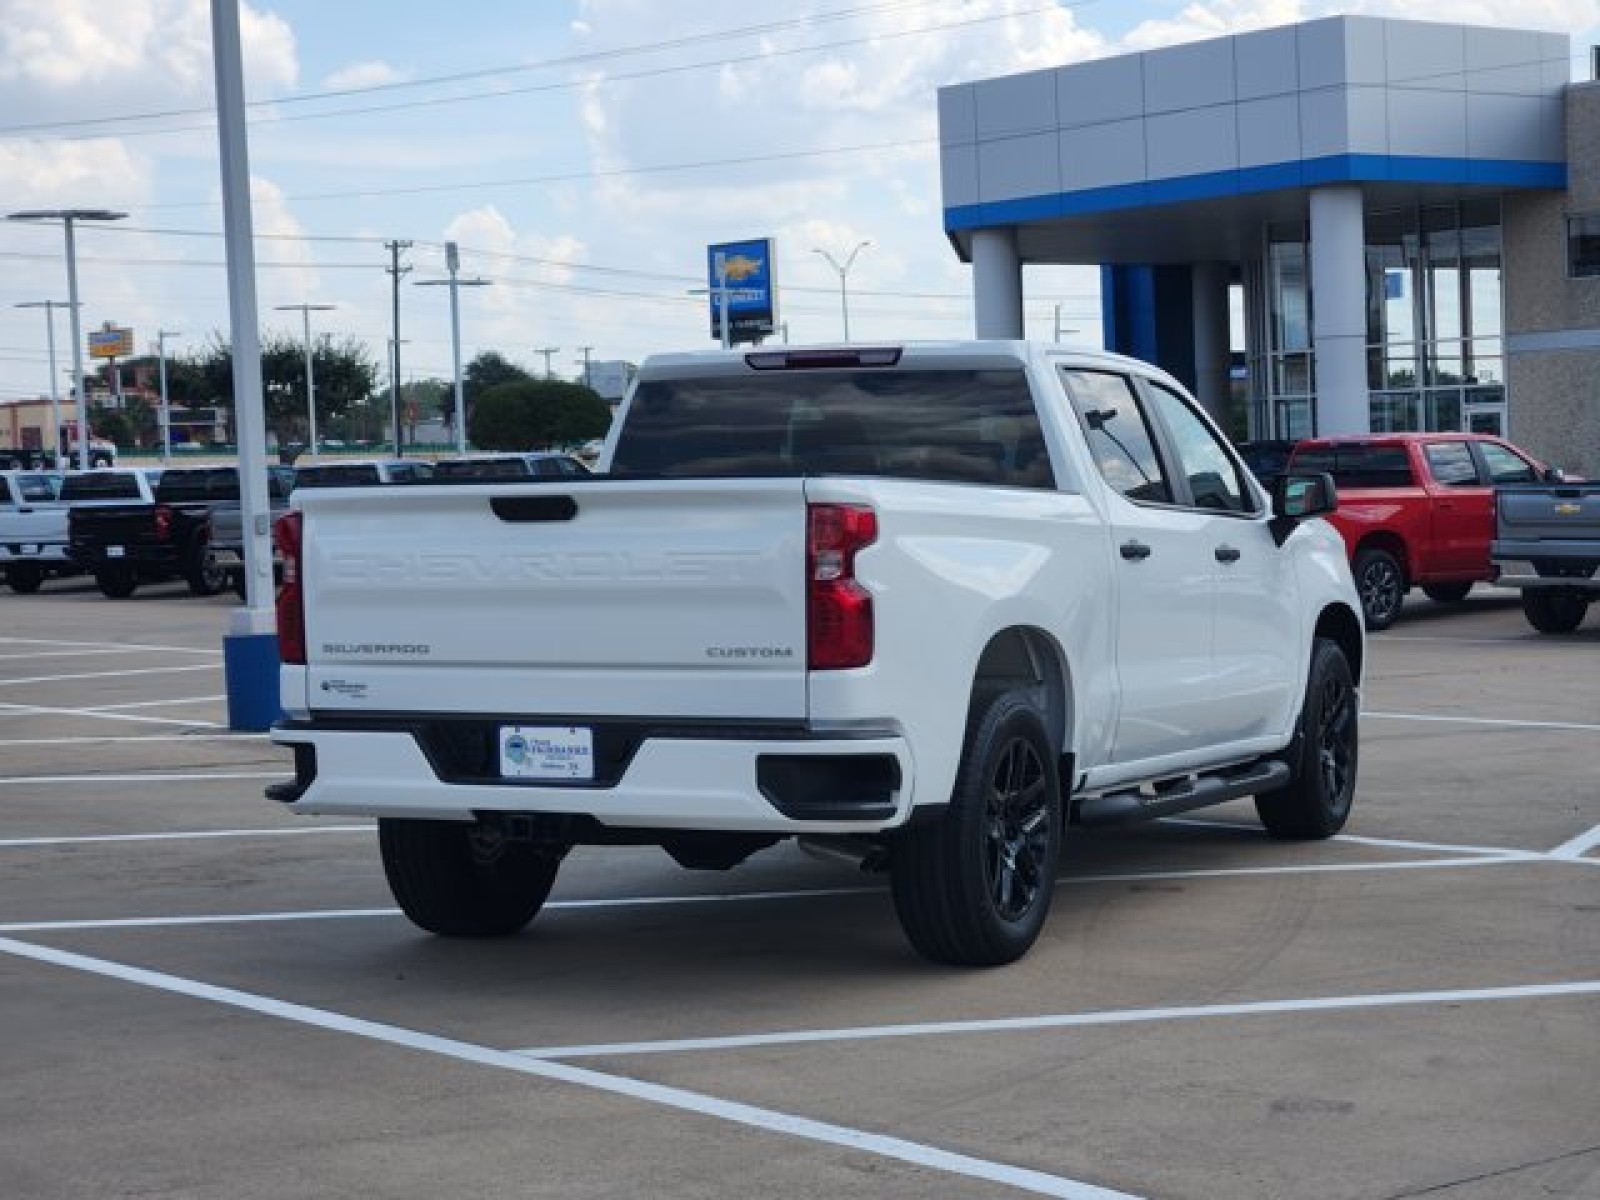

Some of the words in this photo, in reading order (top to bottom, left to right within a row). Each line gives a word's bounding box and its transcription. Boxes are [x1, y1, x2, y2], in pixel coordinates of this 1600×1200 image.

[327, 550, 762, 581] CHEVROLET
[322, 644, 431, 654] SILVERADO
[705, 647, 793, 658] CUSTOM
